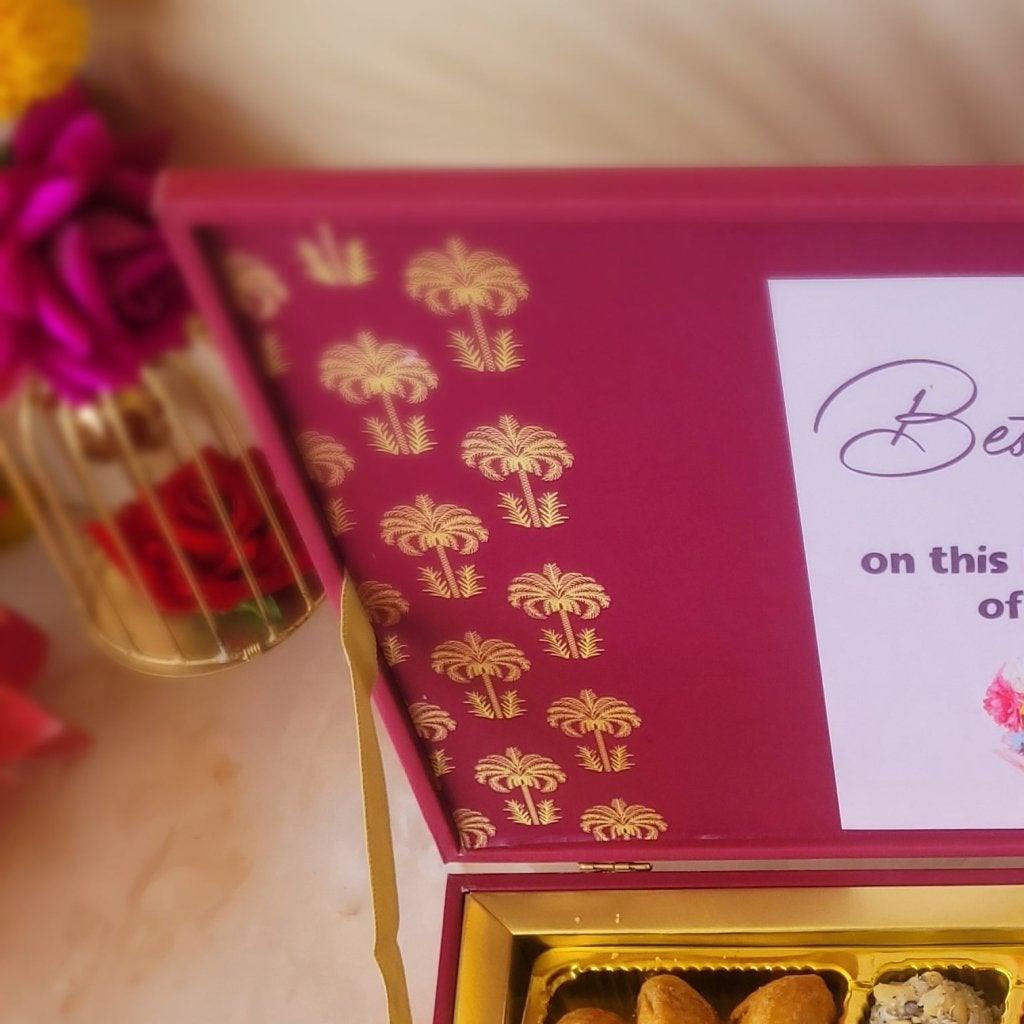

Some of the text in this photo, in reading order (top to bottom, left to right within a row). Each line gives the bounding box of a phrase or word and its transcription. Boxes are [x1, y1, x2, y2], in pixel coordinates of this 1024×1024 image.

[861, 552, 916, 575] on
[929, 545, 1009, 575] this
[977, 589, 1024, 620] of
